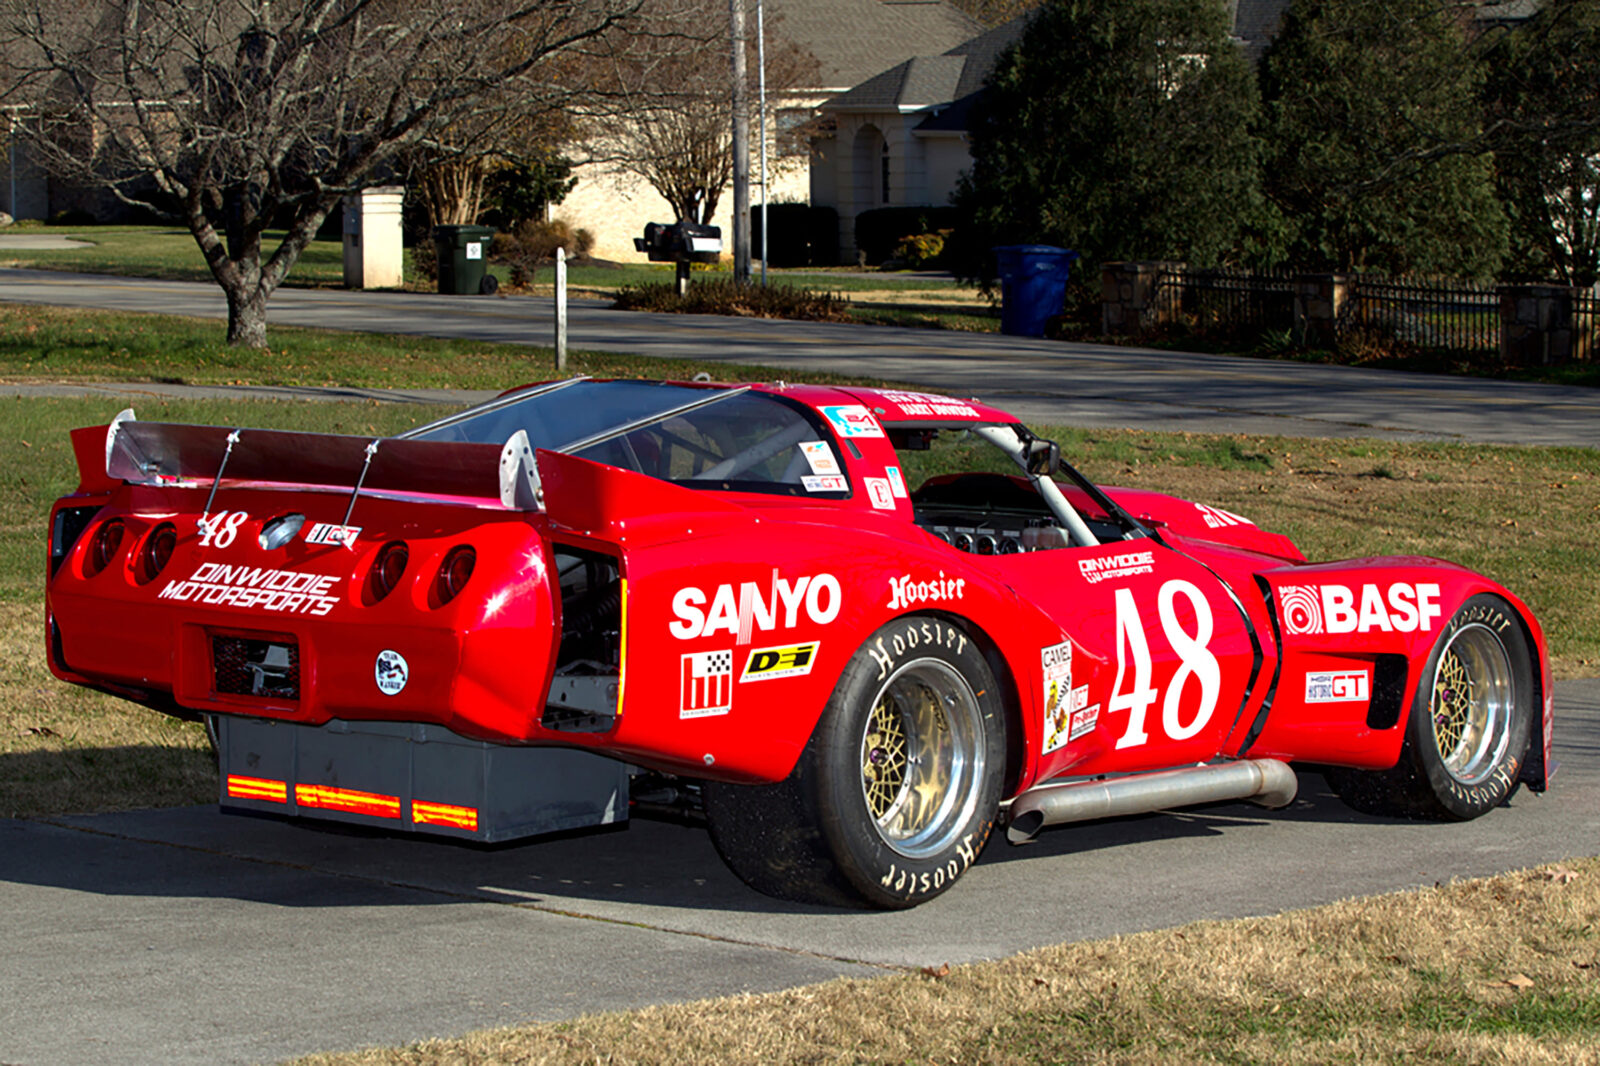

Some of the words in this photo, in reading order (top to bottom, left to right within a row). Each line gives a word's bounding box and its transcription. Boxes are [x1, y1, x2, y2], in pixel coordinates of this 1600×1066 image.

[198, 510, 248, 549] 48
[190, 562, 341, 596] DINWIDDIE
[1078, 551, 1155, 572] DINWIDDIE
[158, 579, 341, 616] MOTORSPORTS
[669, 568, 842, 645] SANYO
[887, 570, 965, 610] Hoosier
[1320, 583, 1441, 634] BASF
[868, 622, 968, 680] Hoosier
[1043, 646, 1071, 668] CAMEL
[1108, 579, 1221, 750] 48
[1333, 675, 1365, 697] GT
[881, 833, 976, 901] Hoosier
